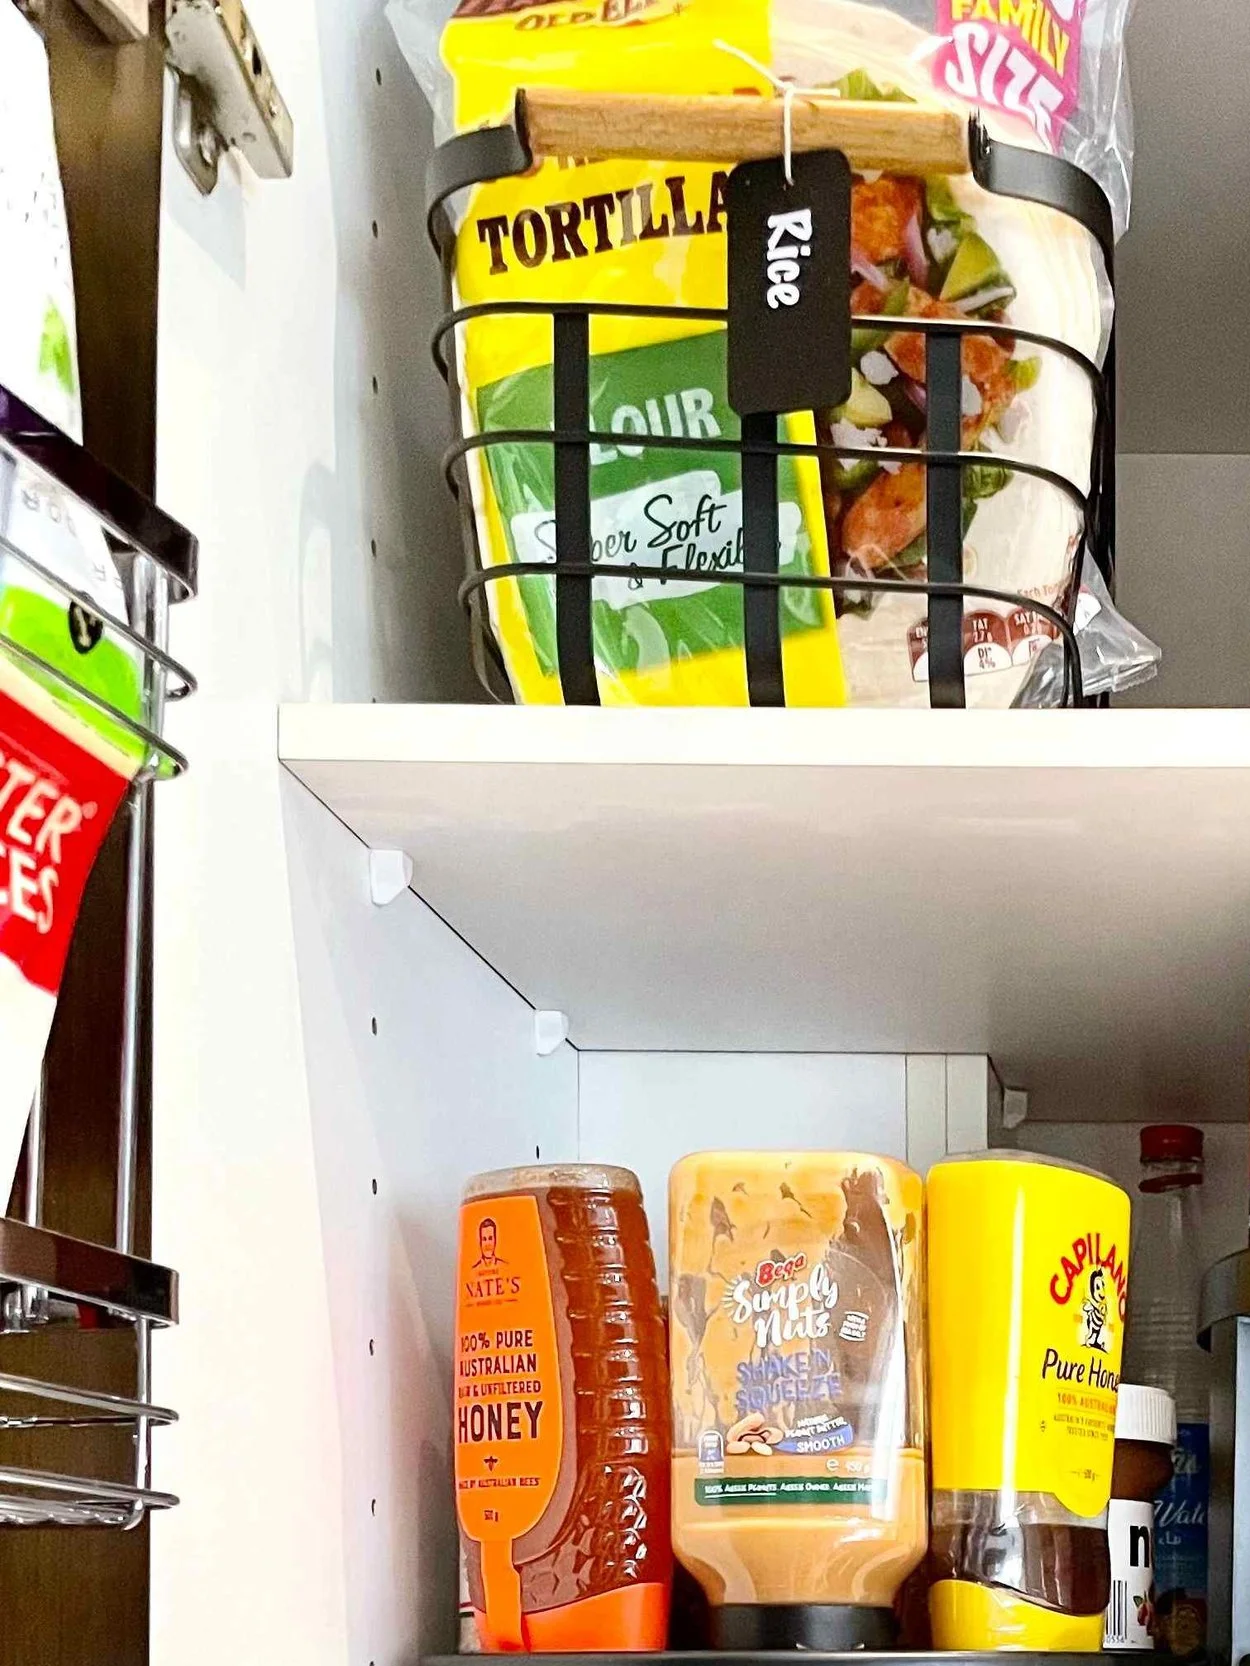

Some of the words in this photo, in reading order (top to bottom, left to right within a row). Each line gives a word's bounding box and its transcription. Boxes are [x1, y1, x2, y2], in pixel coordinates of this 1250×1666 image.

[951, 0, 1070, 79] FAMILY
[766, 208, 813, 309] Rice
[552, 388, 722, 466] LOUR
[644, 494, 728, 548] Soft
[0, 757, 83, 865] TER
[0, 845, 60, 934] ES
[757, 1253, 806, 1287] Bega
[732, 1262, 839, 1324] Simply
[461, 1332, 490, 1353] 100%
[496, 1329, 533, 1349] PURE
[755, 1305, 831, 1349] Nuts
[460, 1353, 537, 1377] AUSTRALIAN
[737, 1351, 810, 1384] SHAKE
[1042, 1348, 1085, 1383] Pure
[736, 1373, 843, 1413] SQUEEZE
[459, 1401, 543, 1444] HONEY
[796, 1434, 846, 1453] SMOOTH
